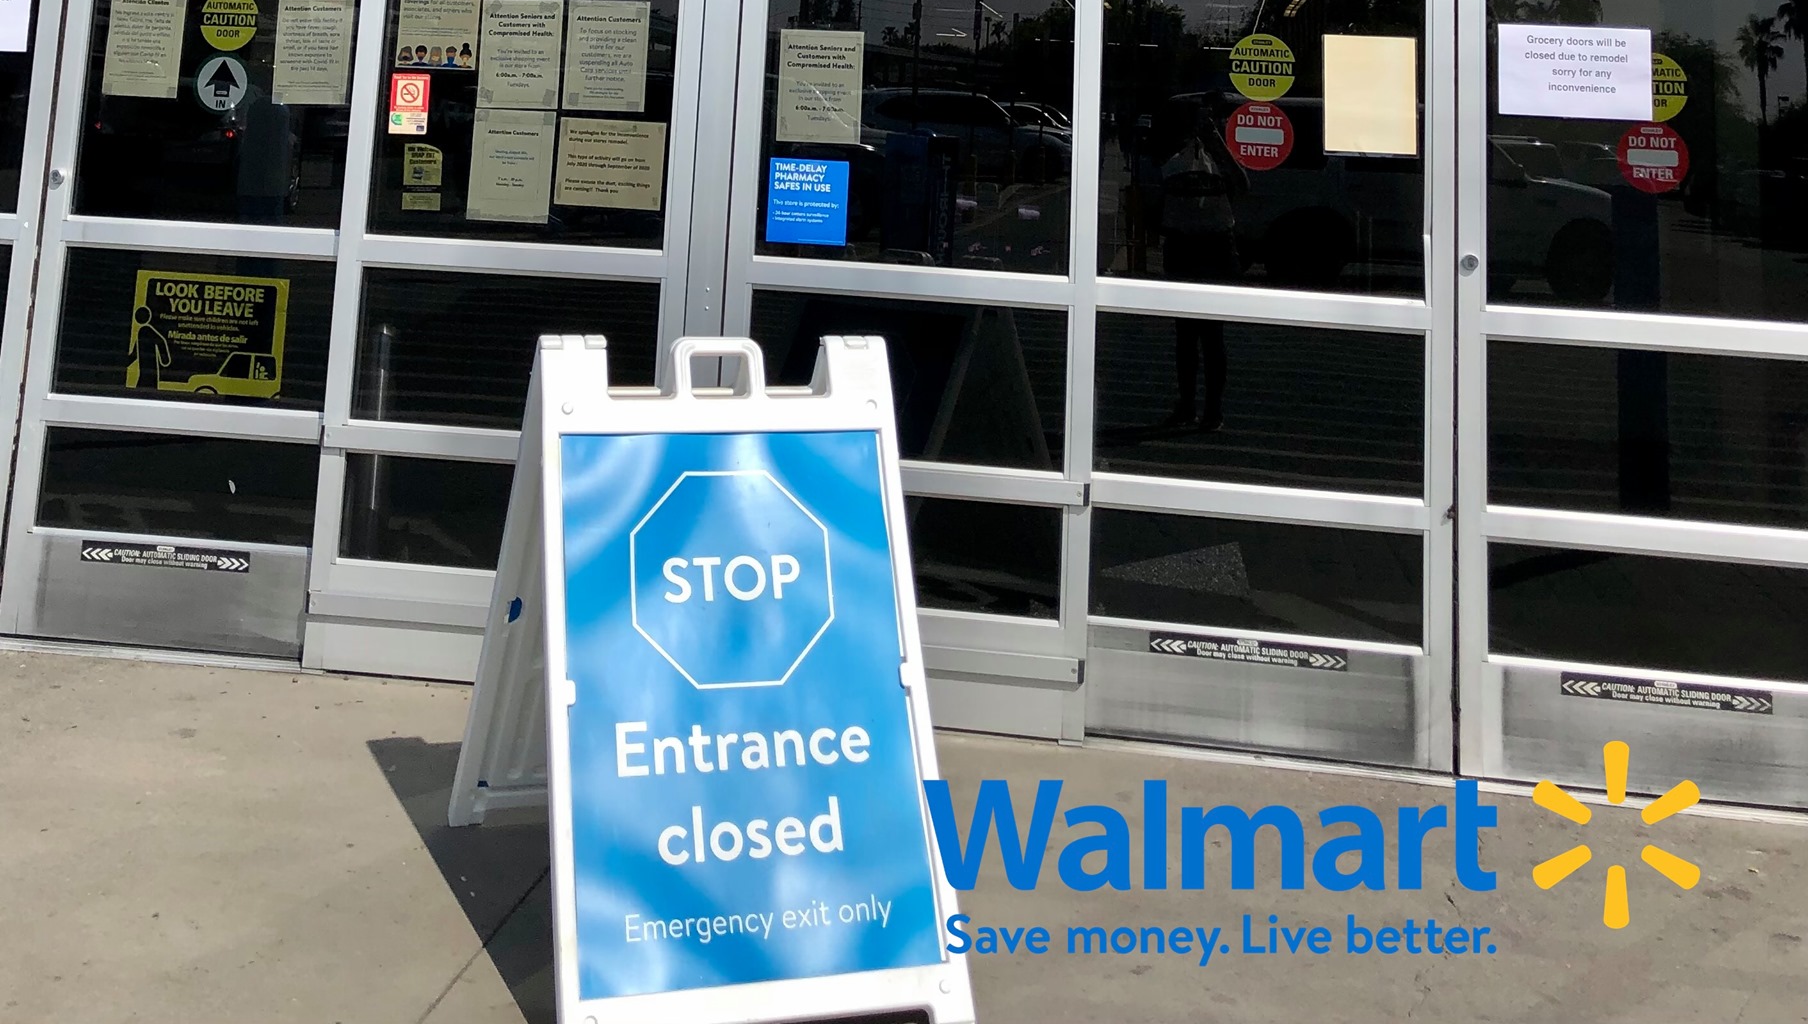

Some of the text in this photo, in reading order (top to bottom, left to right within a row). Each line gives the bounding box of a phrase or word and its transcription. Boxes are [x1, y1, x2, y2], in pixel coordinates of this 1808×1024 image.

[206, 1, 254, 11] AUTOMATIC
[203, 13, 256, 26] CAUTION
[576, 15, 642, 24] Attention Customers
[216, 29, 240, 38] DOOR
[488, 29, 531, 38] Compromised
[788, 44, 819, 52] Attention
[819, 44, 843, 53] Seniors
[1526, 34, 1627, 49] Grocery doors will be
[797, 52, 846, 61] Customers with
[1234, 47, 1291, 59] AUTOMATIC
[1524, 50, 1629, 64] closed due to remodel
[787, 61, 831, 70] Compromised
[1232, 60, 1293, 75] CAUTION
[1551, 67, 1612, 81] sorry for any
[1652, 68, 1681, 78] MATIC
[1248, 77, 1276, 88] DOOR
[1548, 81, 1617, 94] inconvenience
[1652, 81, 1685, 95] TION
[215, 100, 226, 109] IN
[1653, 98, 1668, 108] OR
[1237, 114, 1284, 128] DO NOT
[1628, 135, 1677, 149] DO NOT
[1239, 144, 1279, 158] ENTER
[775, 162, 828, 174] TIME-DELAY
[1633, 166, 1673, 180] ENTER
[774, 171, 826, 183] PHARMACY
[774, 181, 831, 193] SAFES IN USE
[773, 198, 784, 206] This
[804, 201, 830, 209] protected
[155, 281, 265, 303] LOOK BEFORE
[169, 297, 254, 319] YOU LEAVE
[159, 312, 177, 321] Please
[177, 314, 194, 322] make
[206, 316, 228, 324] children
[167, 330, 248, 344] Mirada antes de salir
[113, 548, 218, 564] CAUTION: AUTOMATIC SLIDING DOOR
[121, 555, 134, 563] Door
[135, 557, 147, 565] may
[163, 559, 184, 567] without
[185, 561, 208, 570] warning
[661, 553, 802, 604] STOP
[1187, 640, 1309, 661] CAUTION: AUTOMATIC SLIDING DOOR
[1196, 649, 1298, 667] Door may close without warning
[1601, 682, 1732, 703] CAUTION: AUTOMATIC SLIDING DOOR
[1612, 690, 1721, 710] Door may close without warning
[615, 721, 872, 778] Entrance
[657, 794, 845, 866] closed
[624, 893, 892, 945] Emergency exit only
